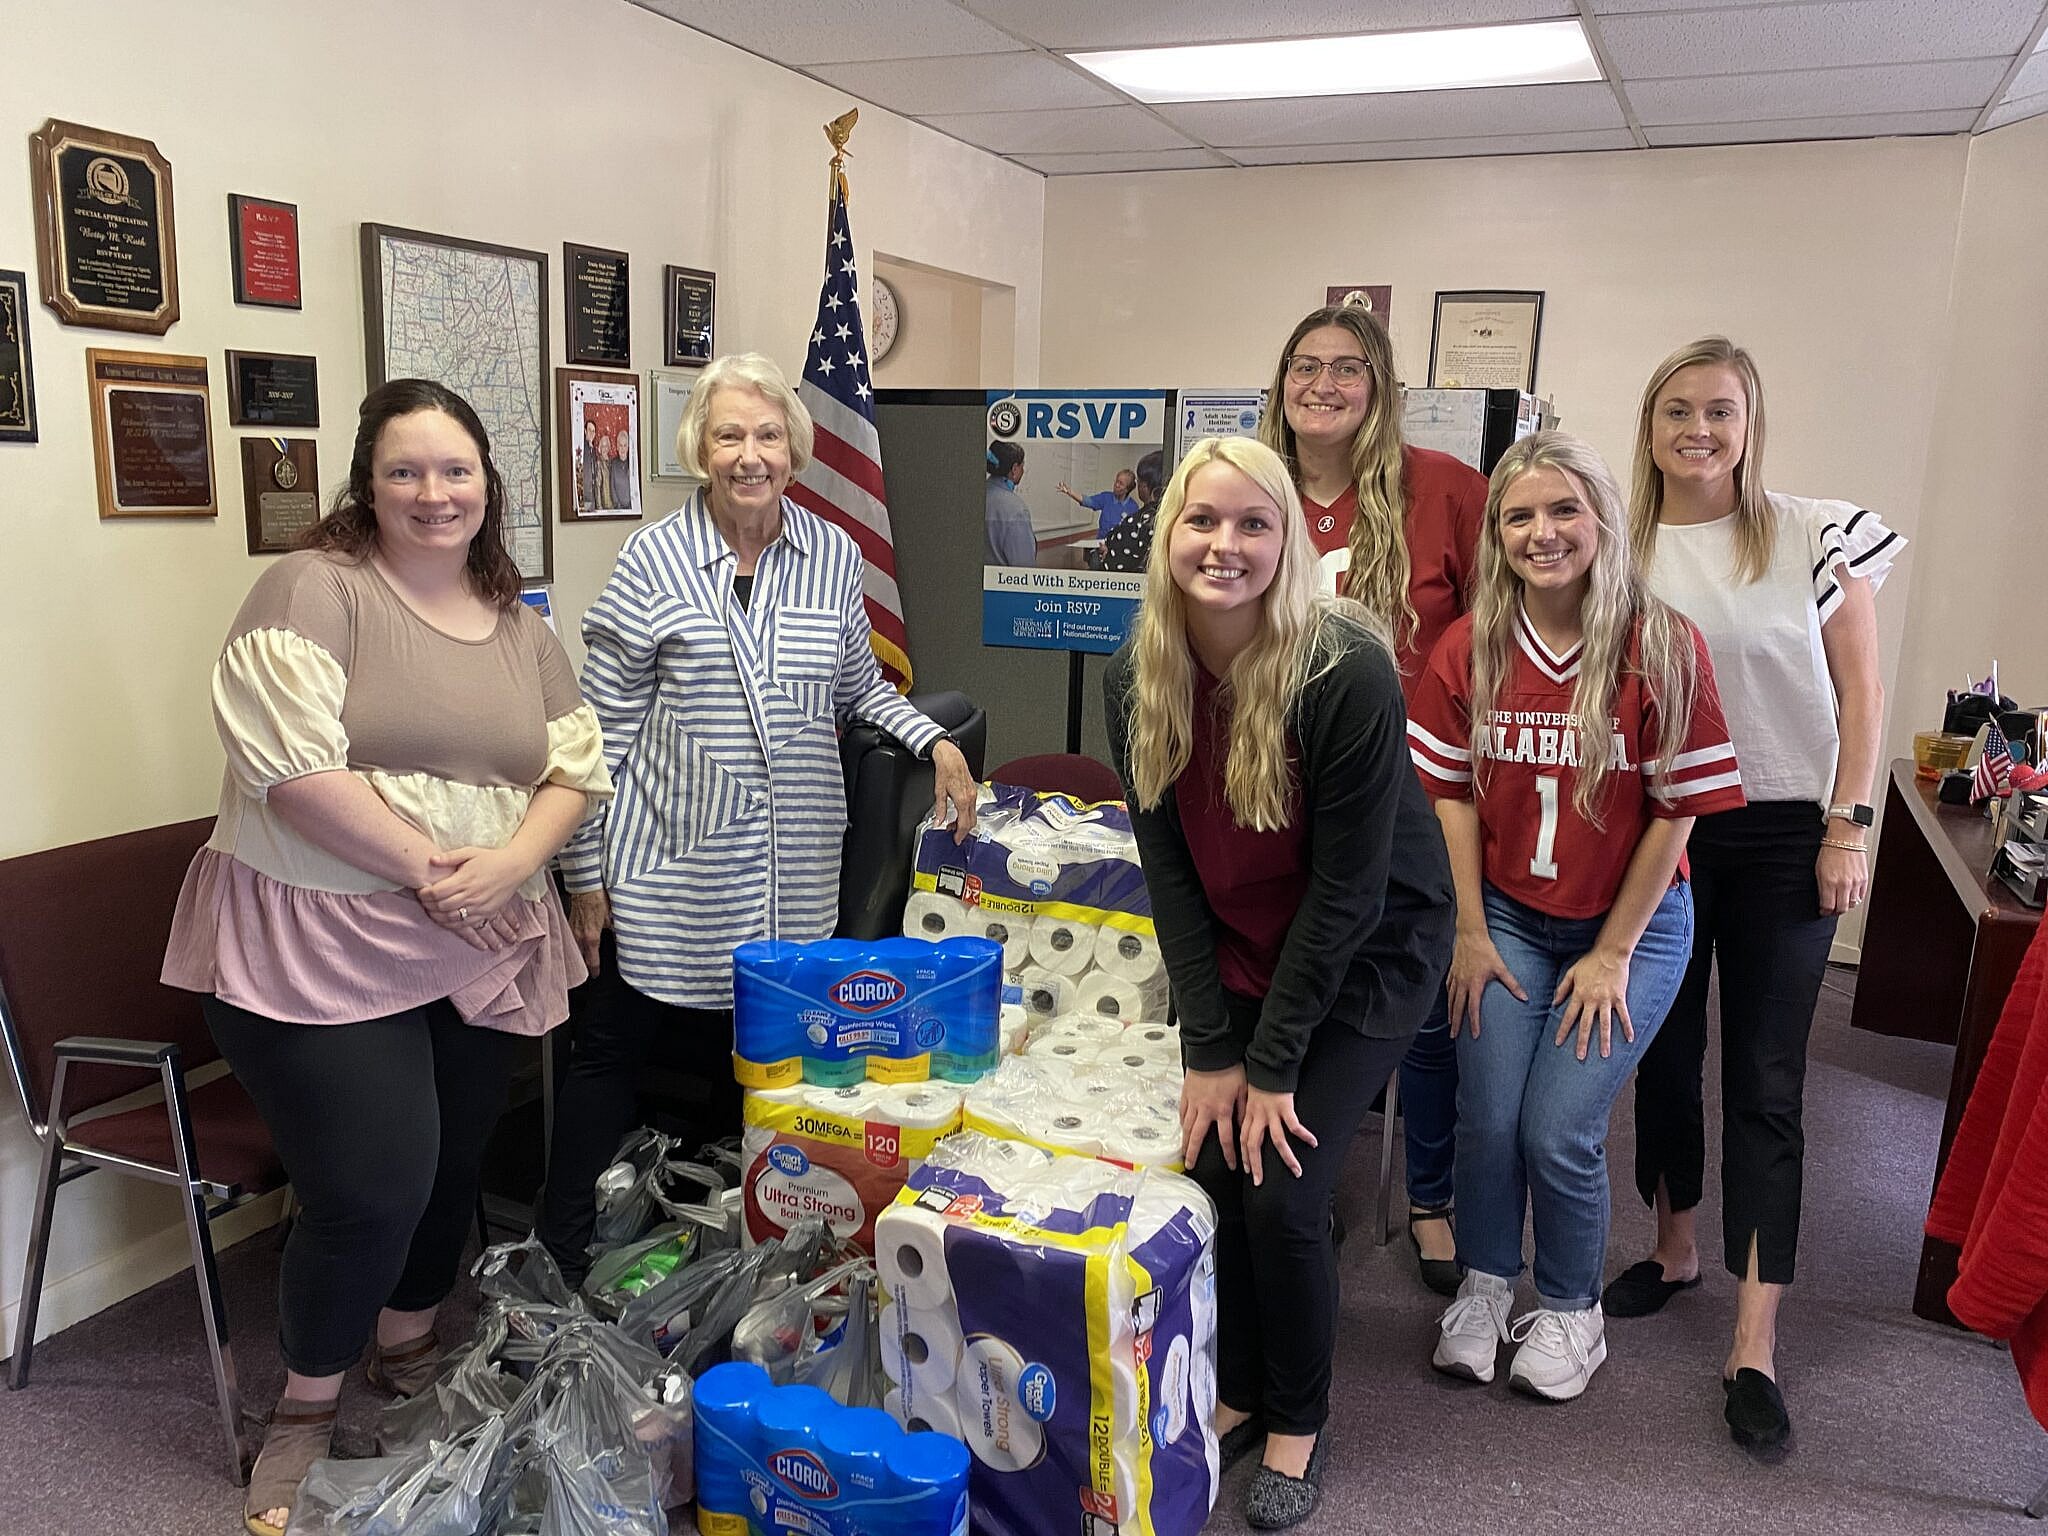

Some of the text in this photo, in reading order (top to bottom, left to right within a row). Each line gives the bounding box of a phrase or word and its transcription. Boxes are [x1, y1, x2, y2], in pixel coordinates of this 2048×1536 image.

[73, 208, 149, 227] SPECIAL APPRECIATION
[108, 221, 118, 229] TO
[1026, 402, 1147, 439] RSVP
[997, 573, 1141, 592] Lead With Experience
[1035, 600, 1101, 616] Join RSVP
[1013, 620, 1043, 628] NATIONAL
[1063, 630, 1121, 641] NationalService.gov
[1480, 725, 1630, 771] ALABAA
[1530, 775, 1558, 880] 1
[986, 899, 1020, 912] DOUBLE
[840, 981, 896, 1002] CLOROX
[838, 1022, 875, 1032] Disinfecting
[815, 1119, 851, 1138] MEGA
[867, 1135, 897, 1154] 120
[772, 1149, 802, 1166] Great
[780, 1160, 802, 1172] Value
[787, 1181, 829, 1198] Premium
[764, 1185, 799, 1208] Ultra
[803, 1196, 856, 1222] Strong
[979, 1359, 994, 1438] Paper Towels
[1034, 1371, 1048, 1414] Great
[988, 1357, 1011, 1453] Ultra Strong
[1093, 1415, 1109, 1436] 12
[1098, 1436, 1110, 1483] DOUBLE
[777, 1455, 830, 1496] CLOROX
[777, 1497, 811, 1518] Disinfecting
[1093, 1493, 1114, 1522] 24
